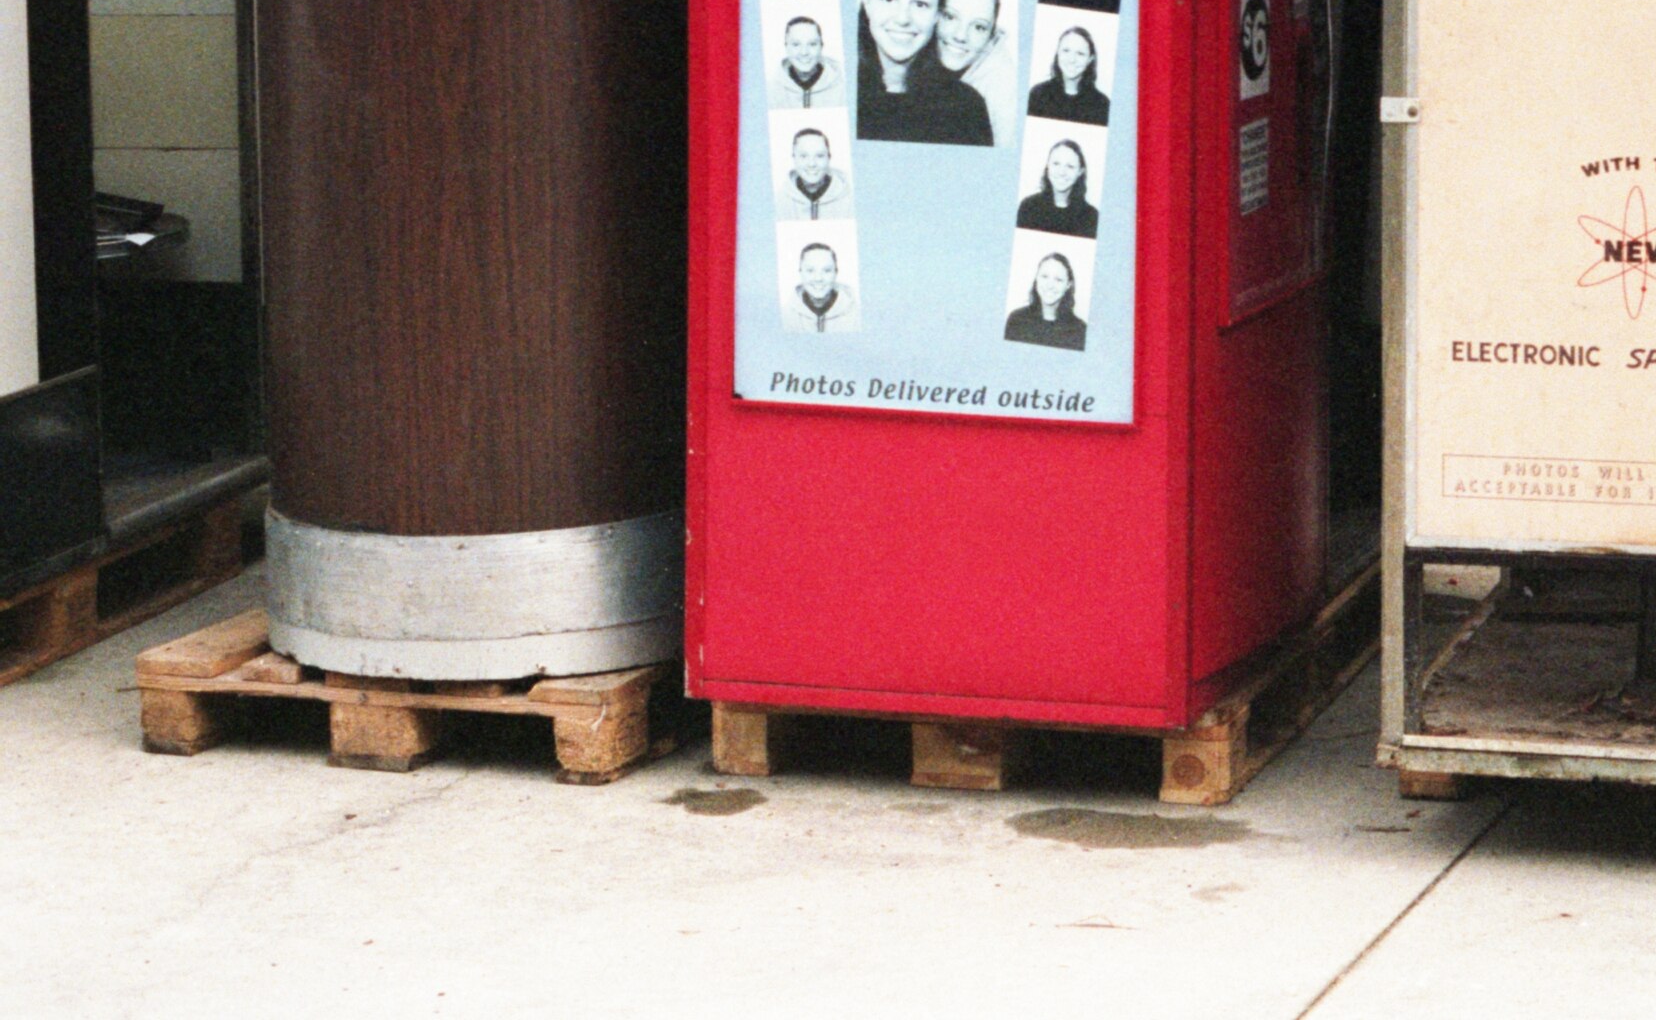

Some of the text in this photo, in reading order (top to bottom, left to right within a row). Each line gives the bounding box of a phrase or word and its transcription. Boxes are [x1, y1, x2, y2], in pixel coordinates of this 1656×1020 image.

[1242, 9, 1267, 68] $6
[1581, 156, 1640, 178] WITH
[1451, 341, 1601, 368] ELECTRONIC
[770, 371, 1095, 414] Photos Delivered outside
[1502, 462, 1581, 478] PHOTOS
[1599, 467, 1645, 482] WILL
[1455, 480, 1577, 498] ACCEPTABLE
[1595, 485, 1632, 500] FOR
